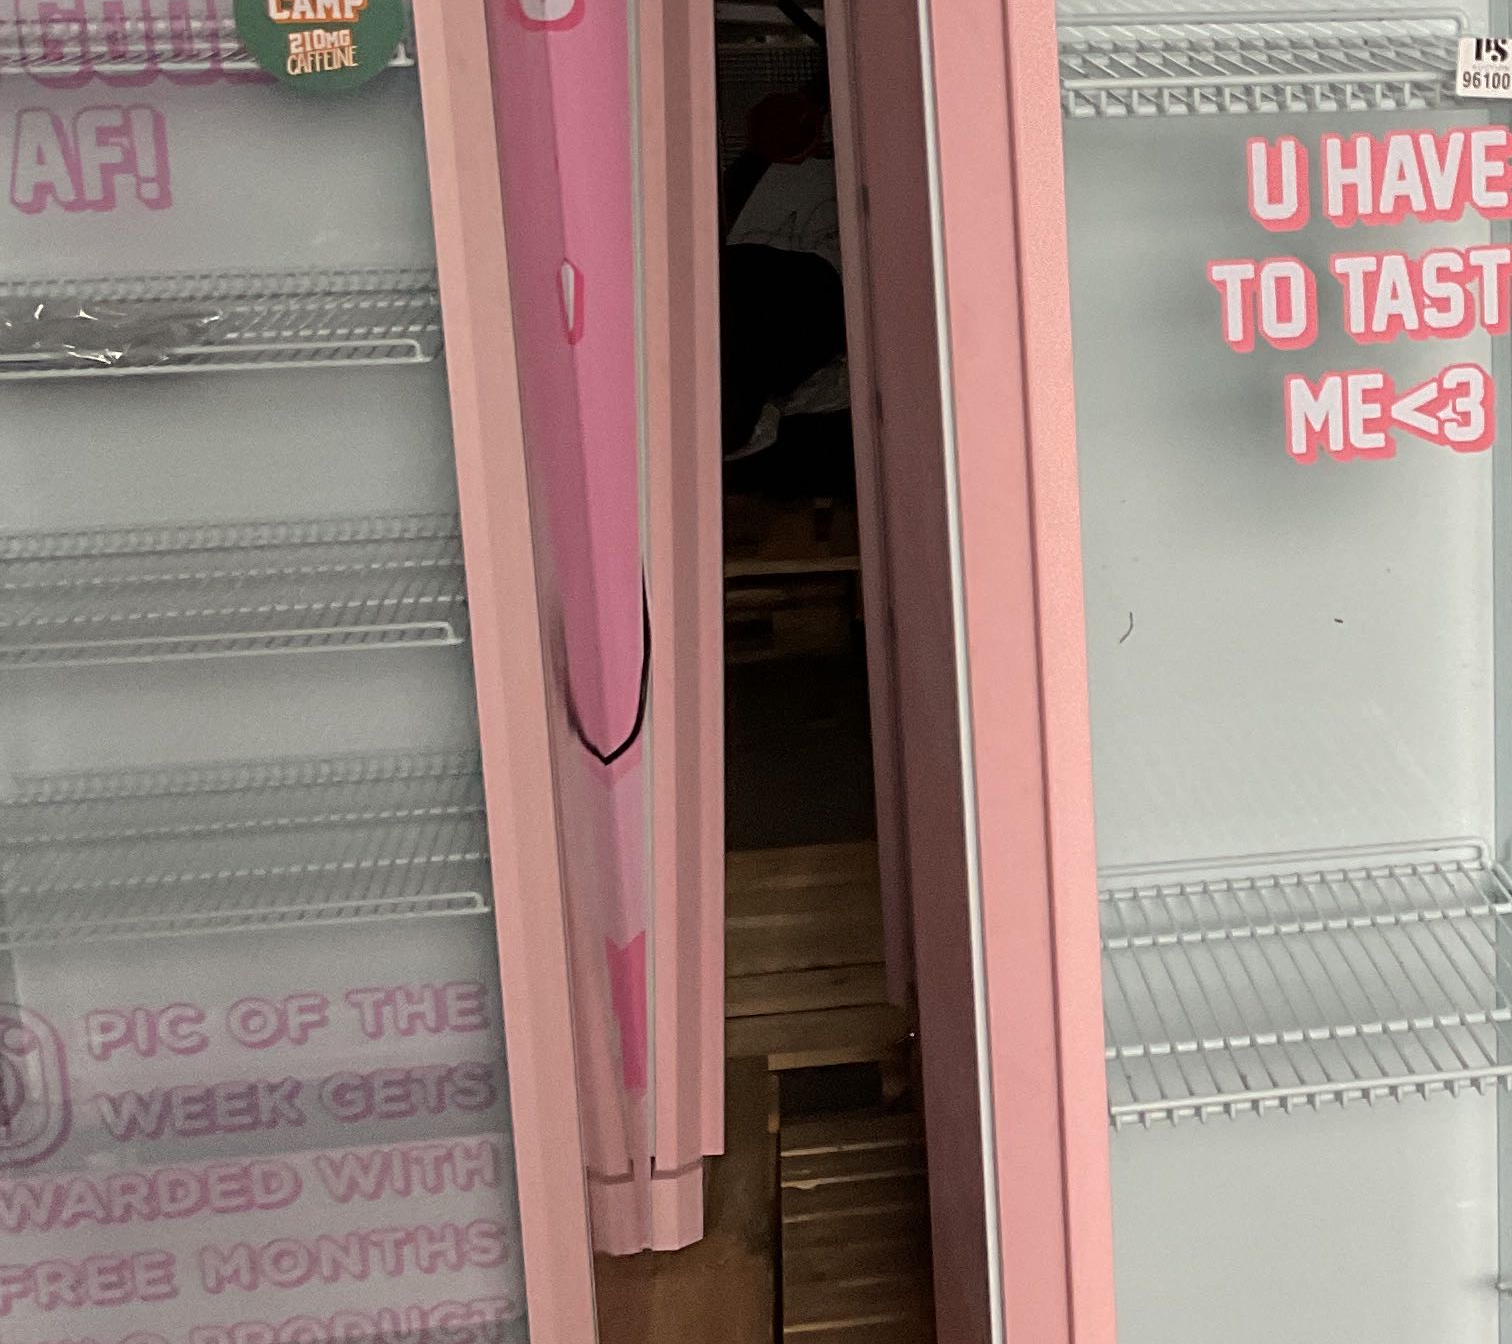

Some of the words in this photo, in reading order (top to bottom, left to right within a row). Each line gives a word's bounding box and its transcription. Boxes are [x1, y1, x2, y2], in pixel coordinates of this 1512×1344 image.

[287, 46, 358, 75] CAFFEINE
[288, 29, 352, 54] 210MG
[10, 103, 172, 213] AF!
[1249, 137, 1305, 228] U
[1209, 258, 1316, 348] TO
[1287, 365, 1493, 460] ME<3
[87, 1003, 207, 1060] PIC
[226, 993, 329, 1049] OF
[346, 982, 490, 1039] THE
[99, 1078, 303, 1141] WEEK
[320, 1062, 496, 1123] GETS
[318, 1140, 496, 1202] WITH
[0, 1251, 177, 1315] FREE
[201, 1220, 507, 1293] MONTHS
